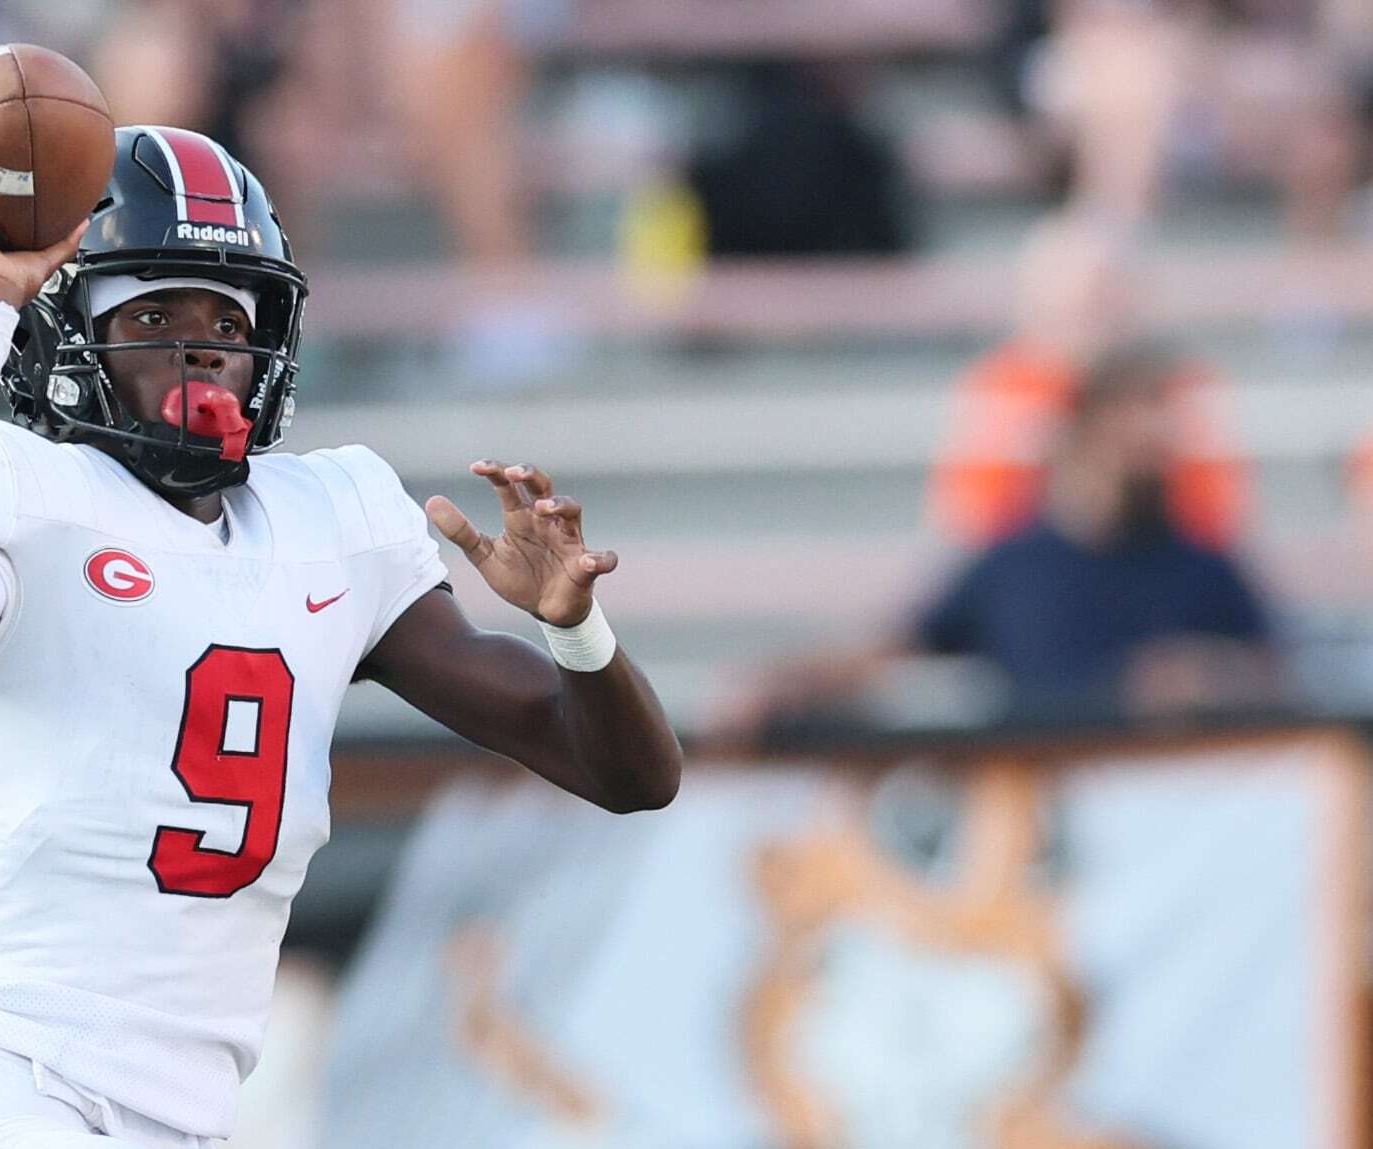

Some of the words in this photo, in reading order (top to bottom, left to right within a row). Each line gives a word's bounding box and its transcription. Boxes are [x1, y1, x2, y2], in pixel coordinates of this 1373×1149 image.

[177, 223, 249, 246] Riddell
[83, 547, 155, 602] G
[146, 643, 295, 898] 9
